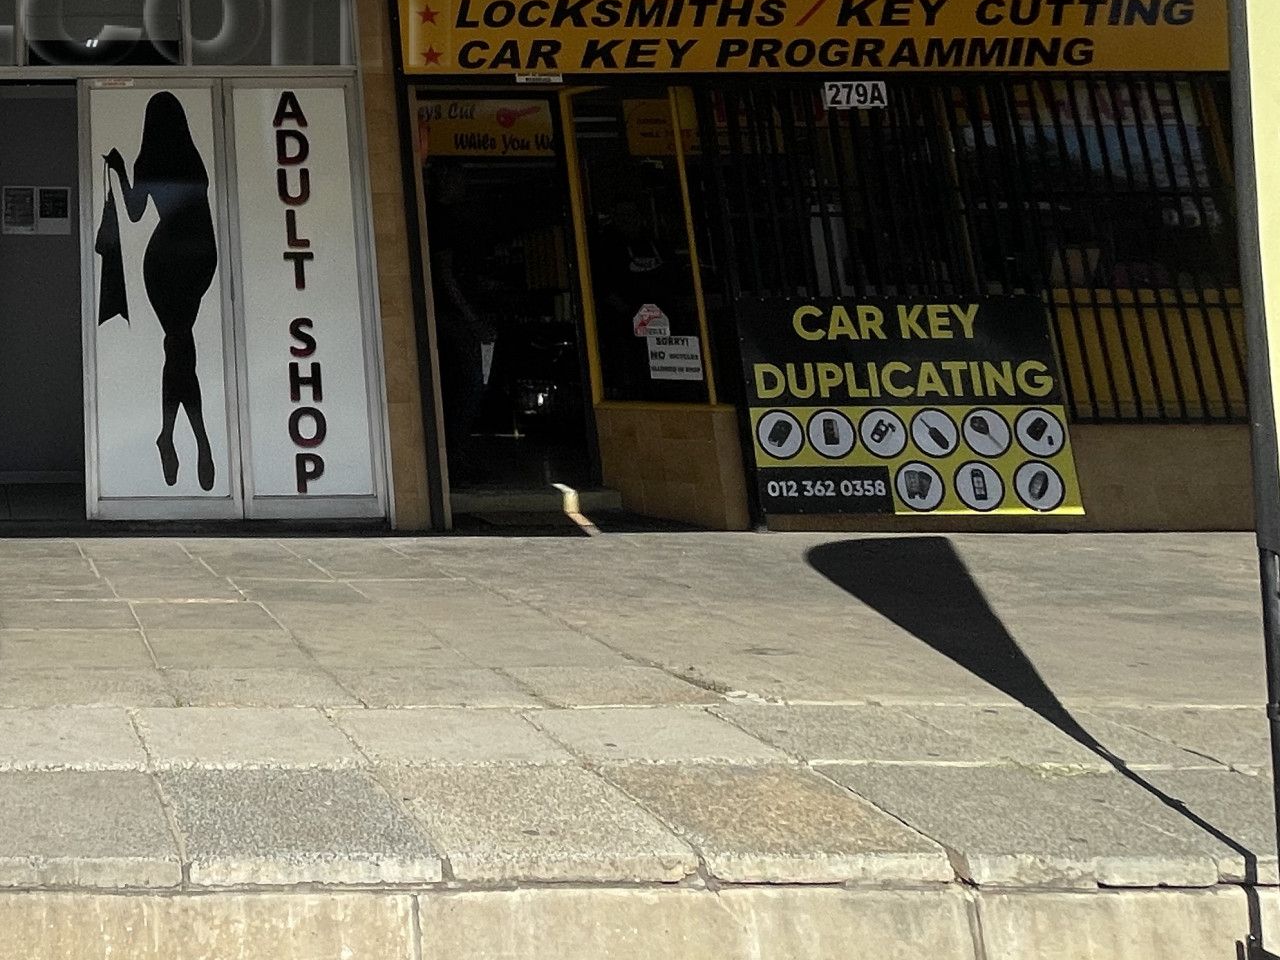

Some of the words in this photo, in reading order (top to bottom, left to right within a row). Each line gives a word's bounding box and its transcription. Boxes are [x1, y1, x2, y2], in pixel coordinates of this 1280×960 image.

[457, 39, 562, 70] CAR
[579, 38, 700, 69] KEY
[714, 37, 1095, 69] PROGRAMMING
[828, 82, 886, 108] 279A
[272, 90, 314, 290] ADULT
[791, 305, 886, 341] CAR
[896, 304, 980, 339] KEY
[752, 360, 1055, 399] DUPLICATING
[287, 316, 328, 495] SHOP
[767, 480, 799, 496] 012
[804, 480, 836, 496] 362
[840, 480, 887, 496] 0358
